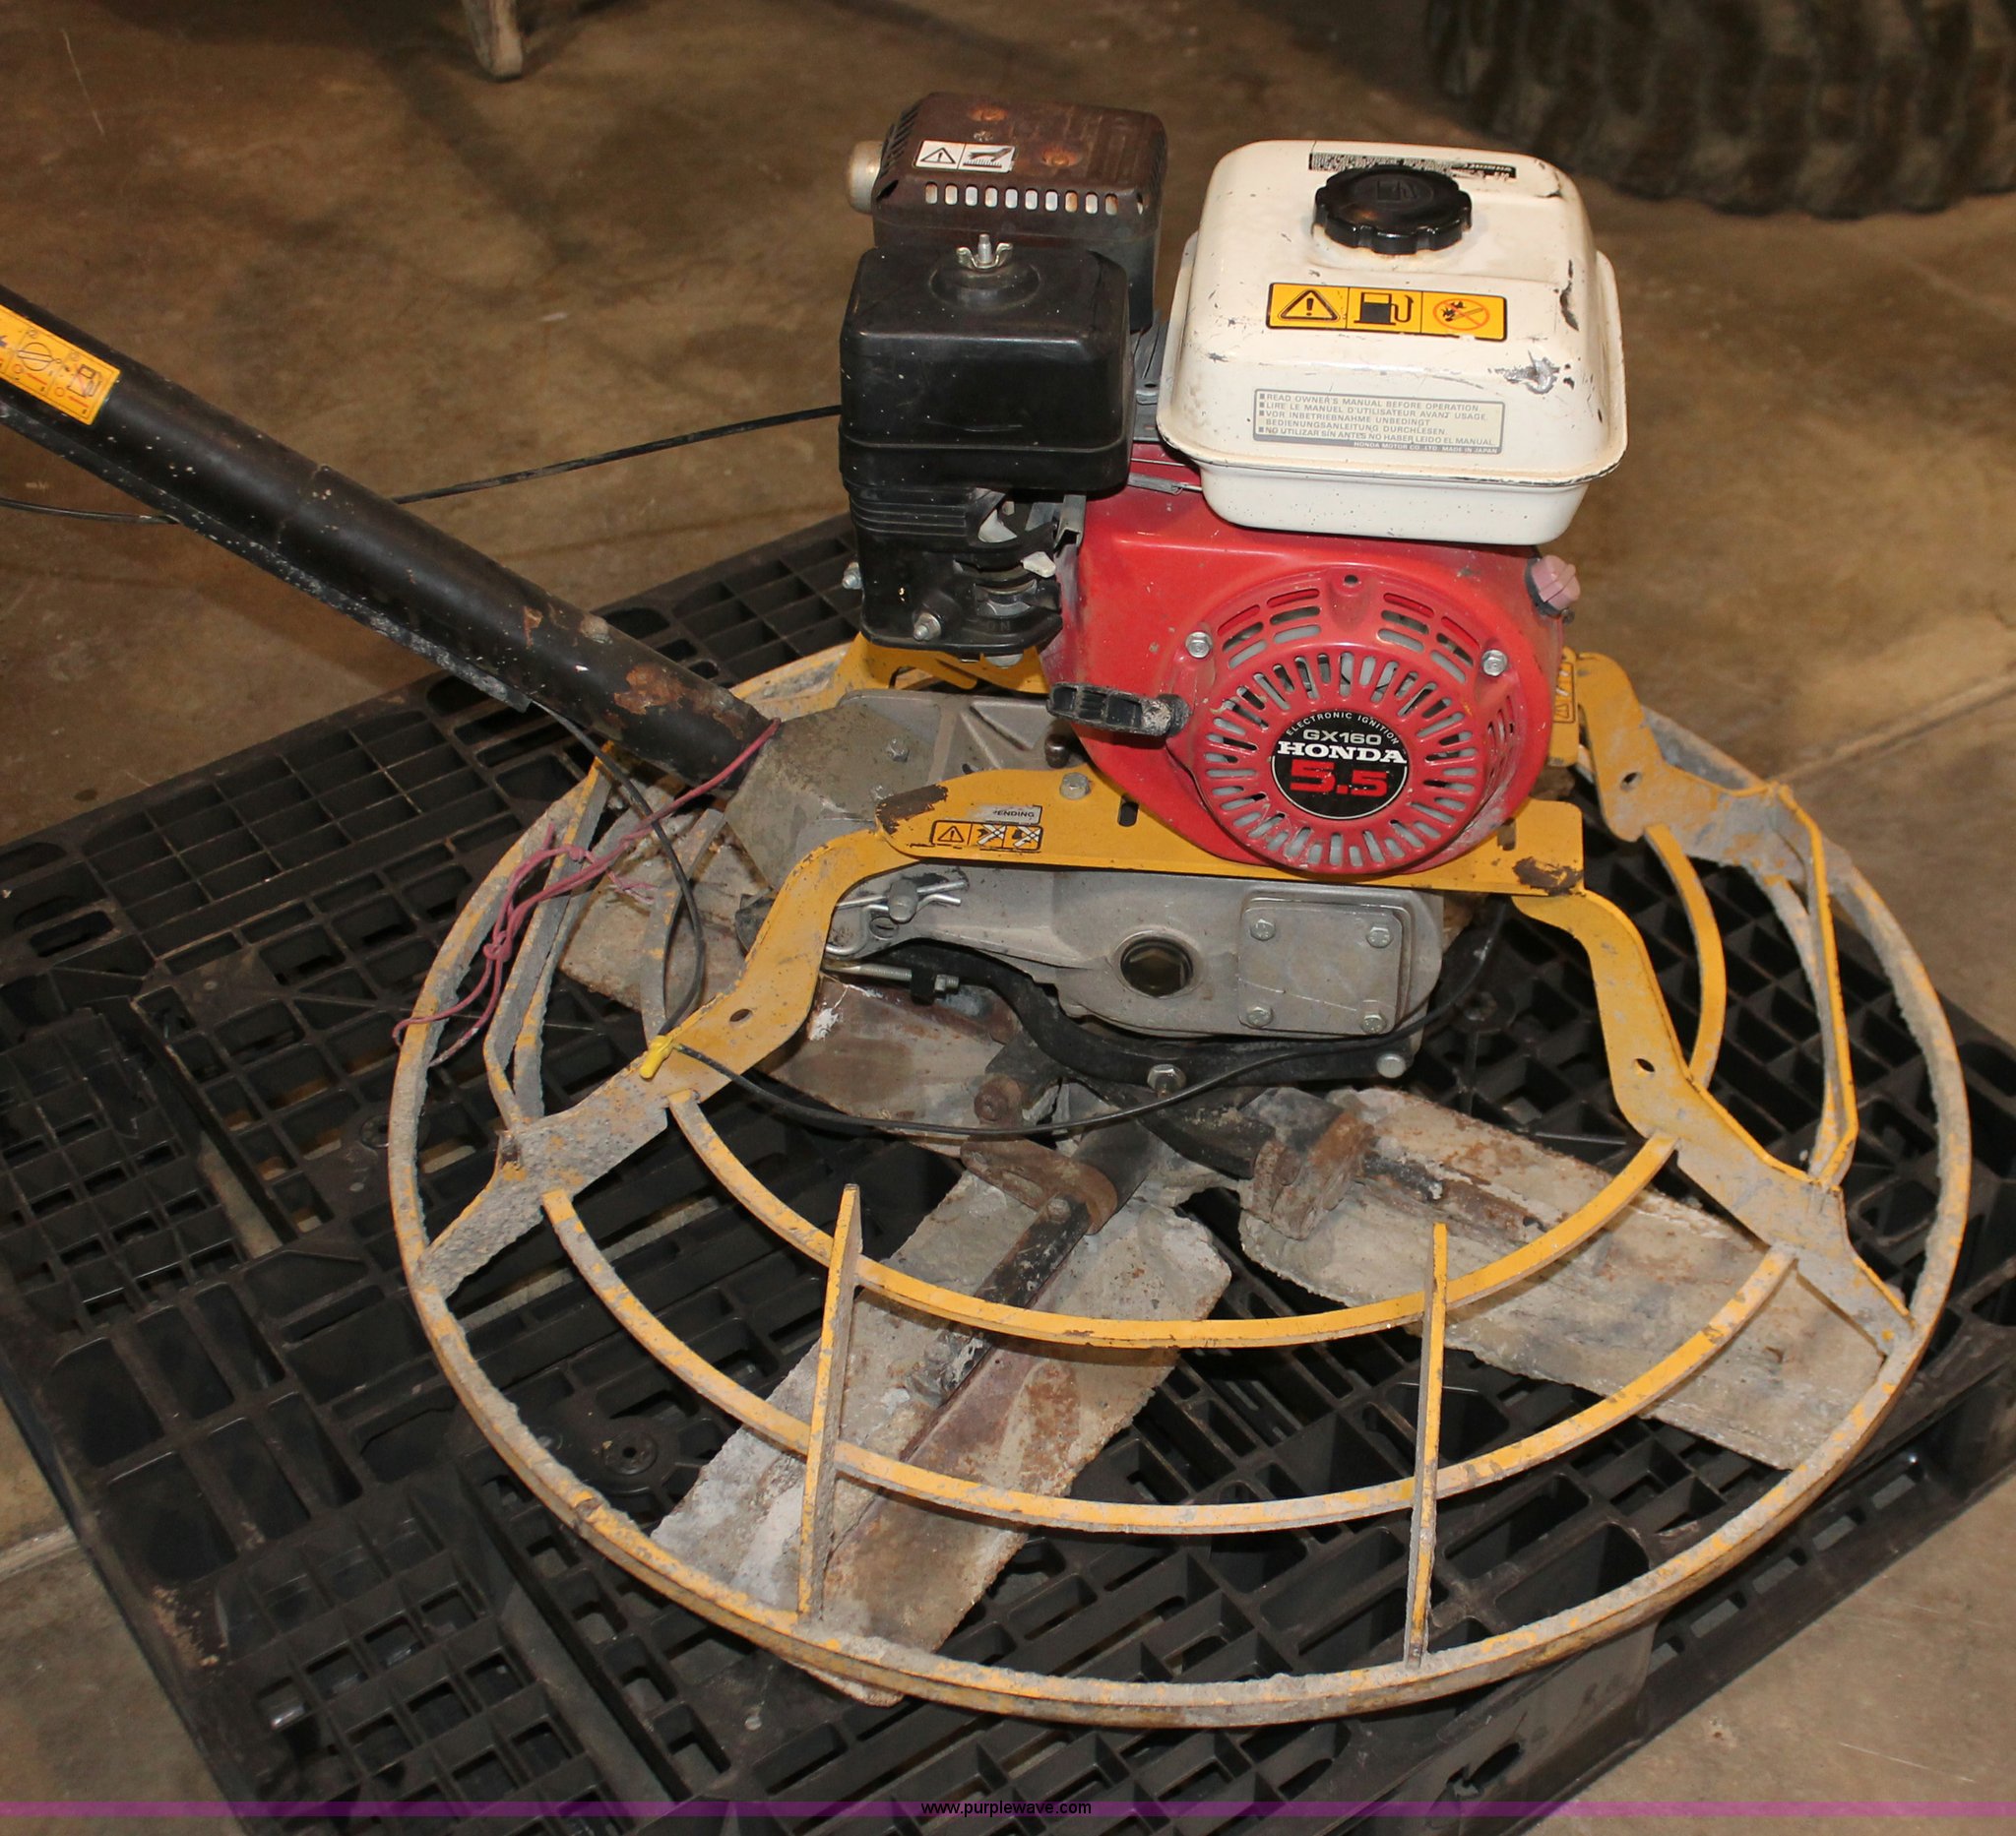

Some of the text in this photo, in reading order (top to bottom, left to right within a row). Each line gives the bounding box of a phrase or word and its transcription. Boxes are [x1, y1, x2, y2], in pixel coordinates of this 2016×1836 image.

[1294, 396, 1339, 405] OWNER'S
[1342, 398, 1382, 407] MANUAL
[1386, 401, 1421, 410] BEFORE
[1266, 410, 1430, 426] VOR INBETRIEBNAHME UNBEDINGT
[1419, 410, 1449, 418] AVANT
[1266, 418, 1379, 432] BEDIENUNGSANLEITUNG
[1281, 427, 1319, 436] UTILIZAR
[1415, 435, 1442, 444] LEIDO
[1286, 712, 1400, 745] ELECTRONIC IGNITION
[1302, 728, 1382, 746] GX160
[1277, 740, 1408, 764] HONDA
[1290, 759, 1389, 797] 5.5
